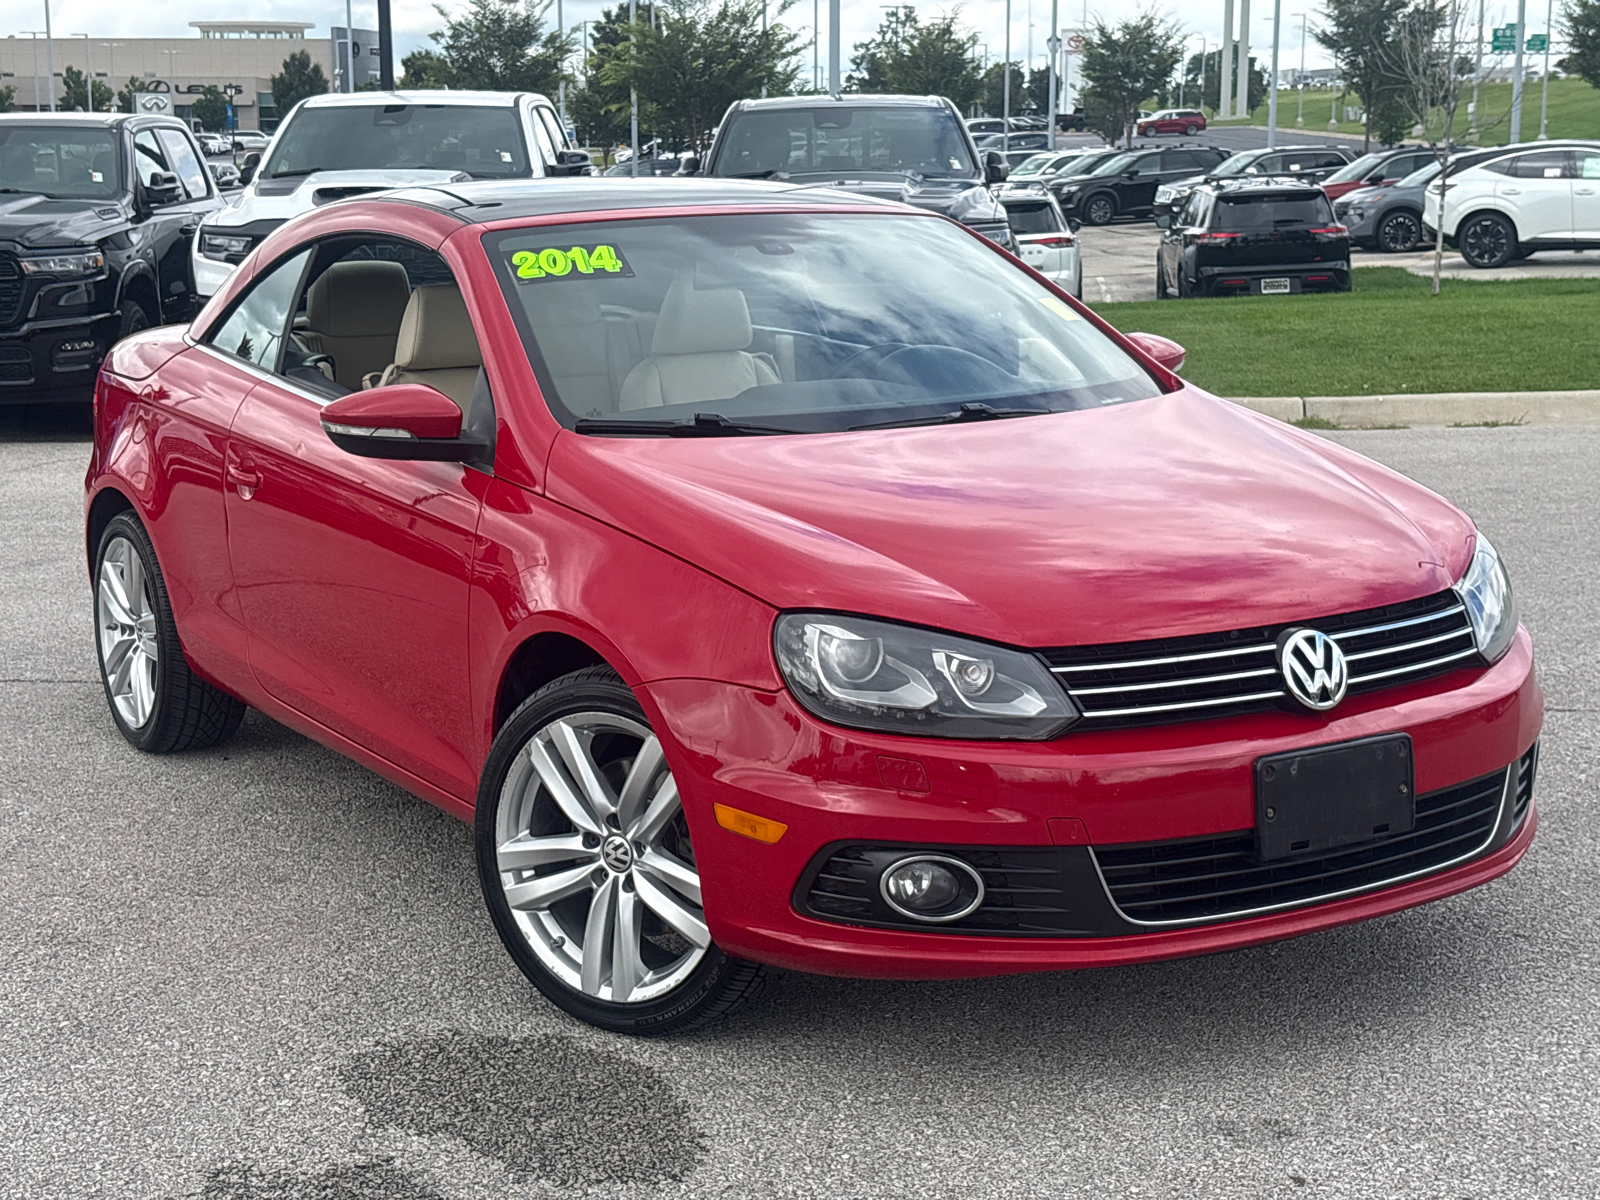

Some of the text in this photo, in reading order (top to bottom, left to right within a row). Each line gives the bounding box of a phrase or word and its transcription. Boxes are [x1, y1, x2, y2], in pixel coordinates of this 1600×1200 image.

[175, 84, 243, 94] LEUS
[511, 245, 623, 279] 2014
[1282, 629, 1348, 710] VW
[604, 835, 633, 872] VW
